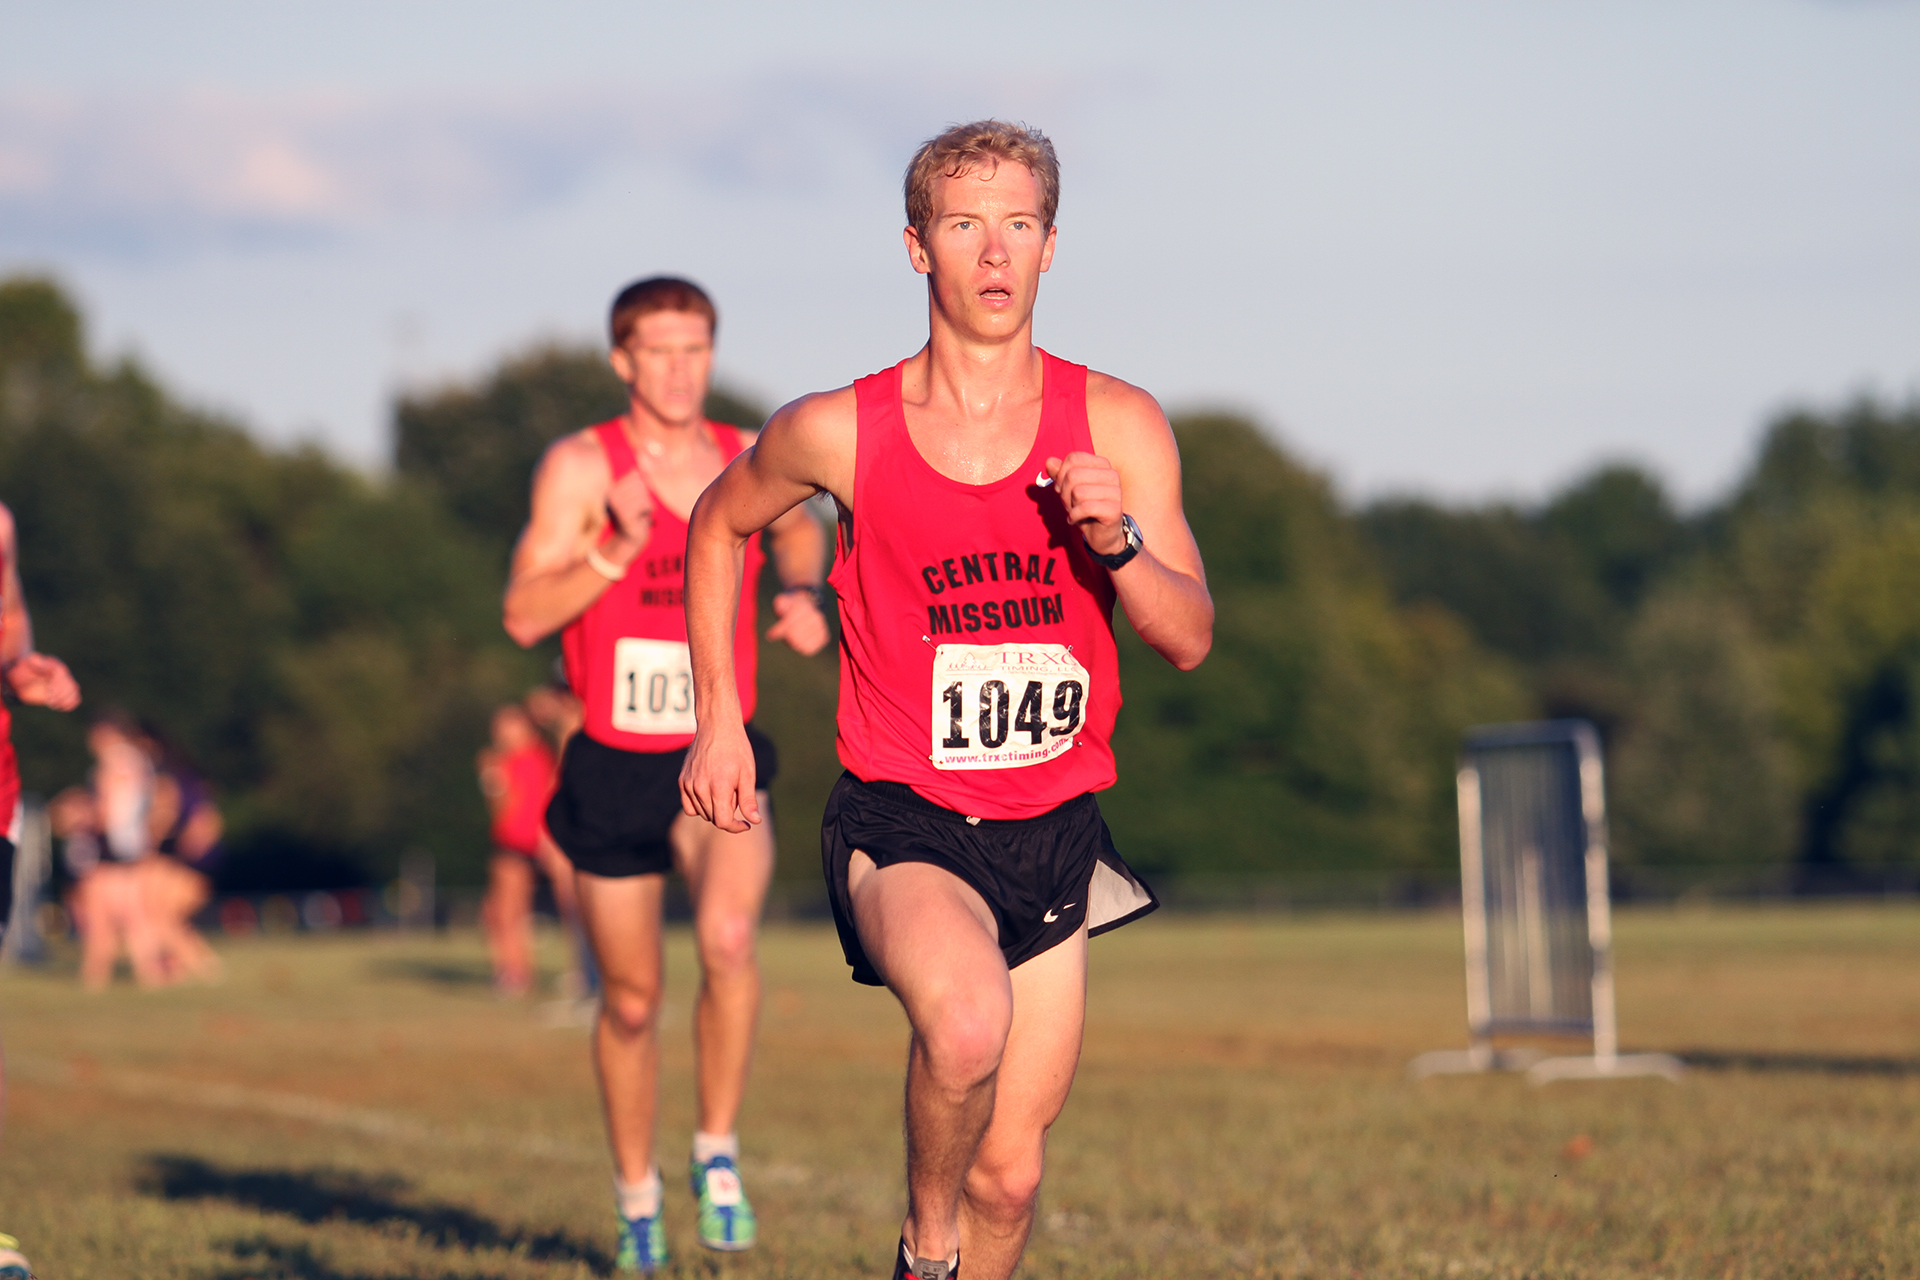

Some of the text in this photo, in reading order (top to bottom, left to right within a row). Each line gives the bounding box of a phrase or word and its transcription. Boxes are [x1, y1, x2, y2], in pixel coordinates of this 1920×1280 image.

[922, 552, 1056, 595] CENTRAL
[928, 594, 1064, 635] MISSOURI
[942, 680, 1083, 748] 1049
